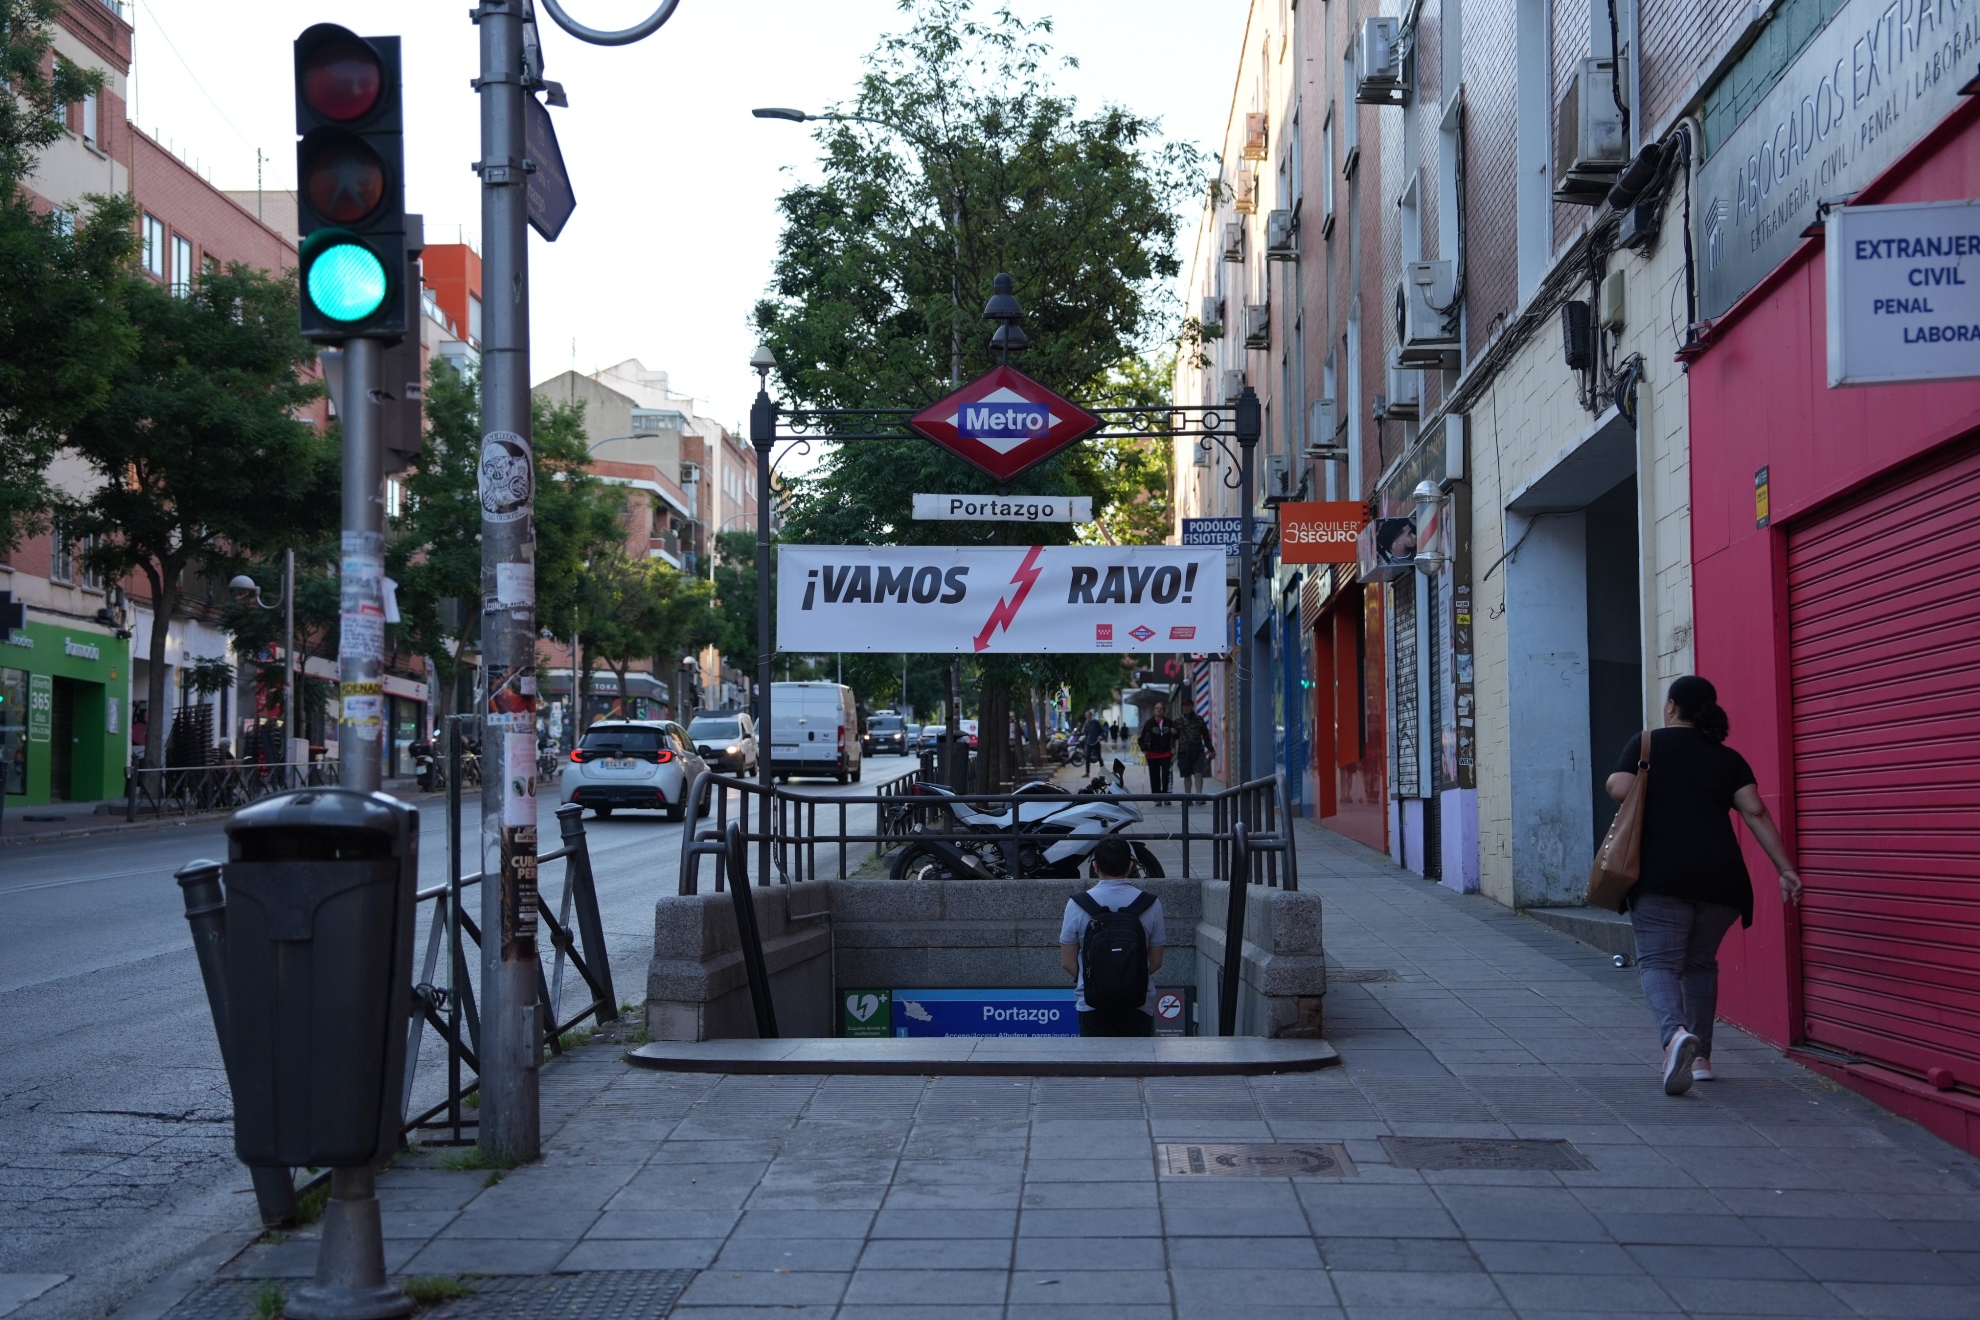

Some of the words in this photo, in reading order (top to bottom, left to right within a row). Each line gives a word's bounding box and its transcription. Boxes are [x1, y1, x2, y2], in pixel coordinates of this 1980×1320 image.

[1736, 59, 1845, 226] ABOGADOS
[1751, 178, 1810, 253] EXTRANJERÍA
[1820, 143, 1848, 187] CIVIL
[1861, 95, 1900, 151] PENAL
[1908, 267, 1966, 287] CIVIL
[1873, 297, 1934, 315] PENAL
[966, 407, 1043, 430] Metro
[950, 499, 1054, 520] Portazgo
[1189, 518, 1242, 533] PODÓLOG
[1299, 530, 1358, 543] SEGURO
[802, 565, 970, 610] ¡VAMOS
[1067, 562, 1199, 604] RAYO!
[32, 692, 50, 710] 365
[983, 1006, 1060, 1024] Portazgo
